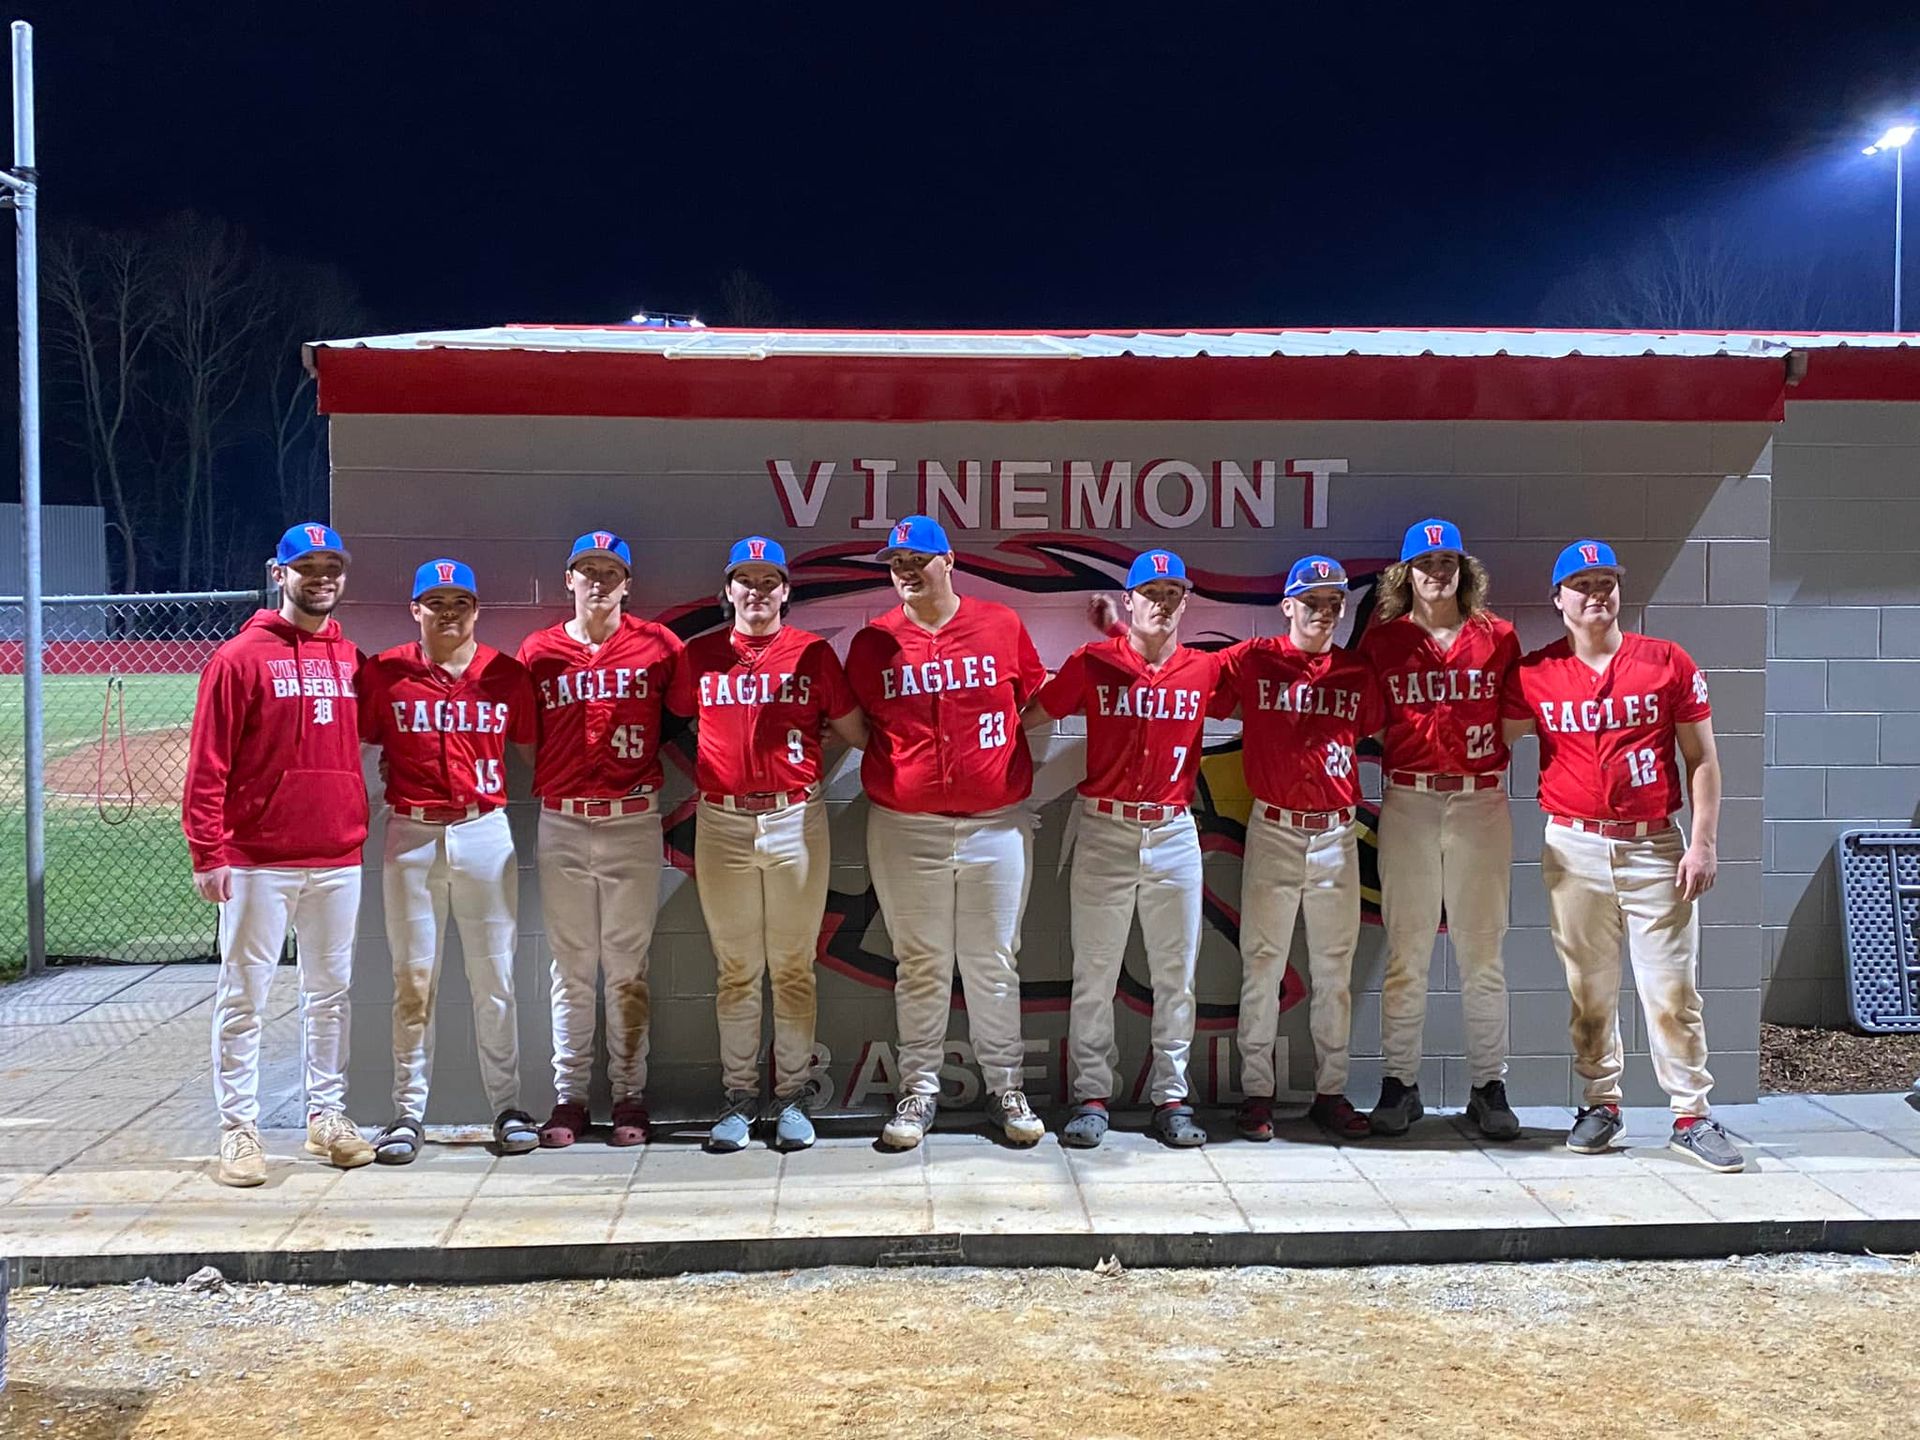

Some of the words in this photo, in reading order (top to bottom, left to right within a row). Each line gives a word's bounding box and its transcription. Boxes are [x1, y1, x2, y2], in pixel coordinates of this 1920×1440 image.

[766, 458, 1348, 530] VINEMONT
[304, 526, 325, 546] V
[592, 533, 612, 549] V
[748, 540, 766, 560] V
[1424, 525, 1443, 546] V
[1151, 554, 1169, 574] V
[1579, 544, 1599, 564] V
[435, 563, 456, 584] V
[540, 668, 648, 709] EAGLES
[700, 673, 811, 706] EAGLES
[881, 655, 998, 700] EAGLES
[1387, 669, 1496, 705] EAGLES
[391, 699, 508, 734] EAGLES
[1096, 685, 1201, 721] EAGLES
[1257, 679, 1361, 721] EAGLES
[1539, 694, 1658, 733] EAGLES
[610, 725, 645, 759] 45
[786, 729, 804, 764] 9
[978, 711, 1007, 749] 23
[1465, 723, 1496, 760] 22
[475, 758, 501, 794] 15
[1169, 746, 1188, 782] 7
[1625, 748, 1658, 788] 12
[769, 1035, 1315, 1110] BASELL
